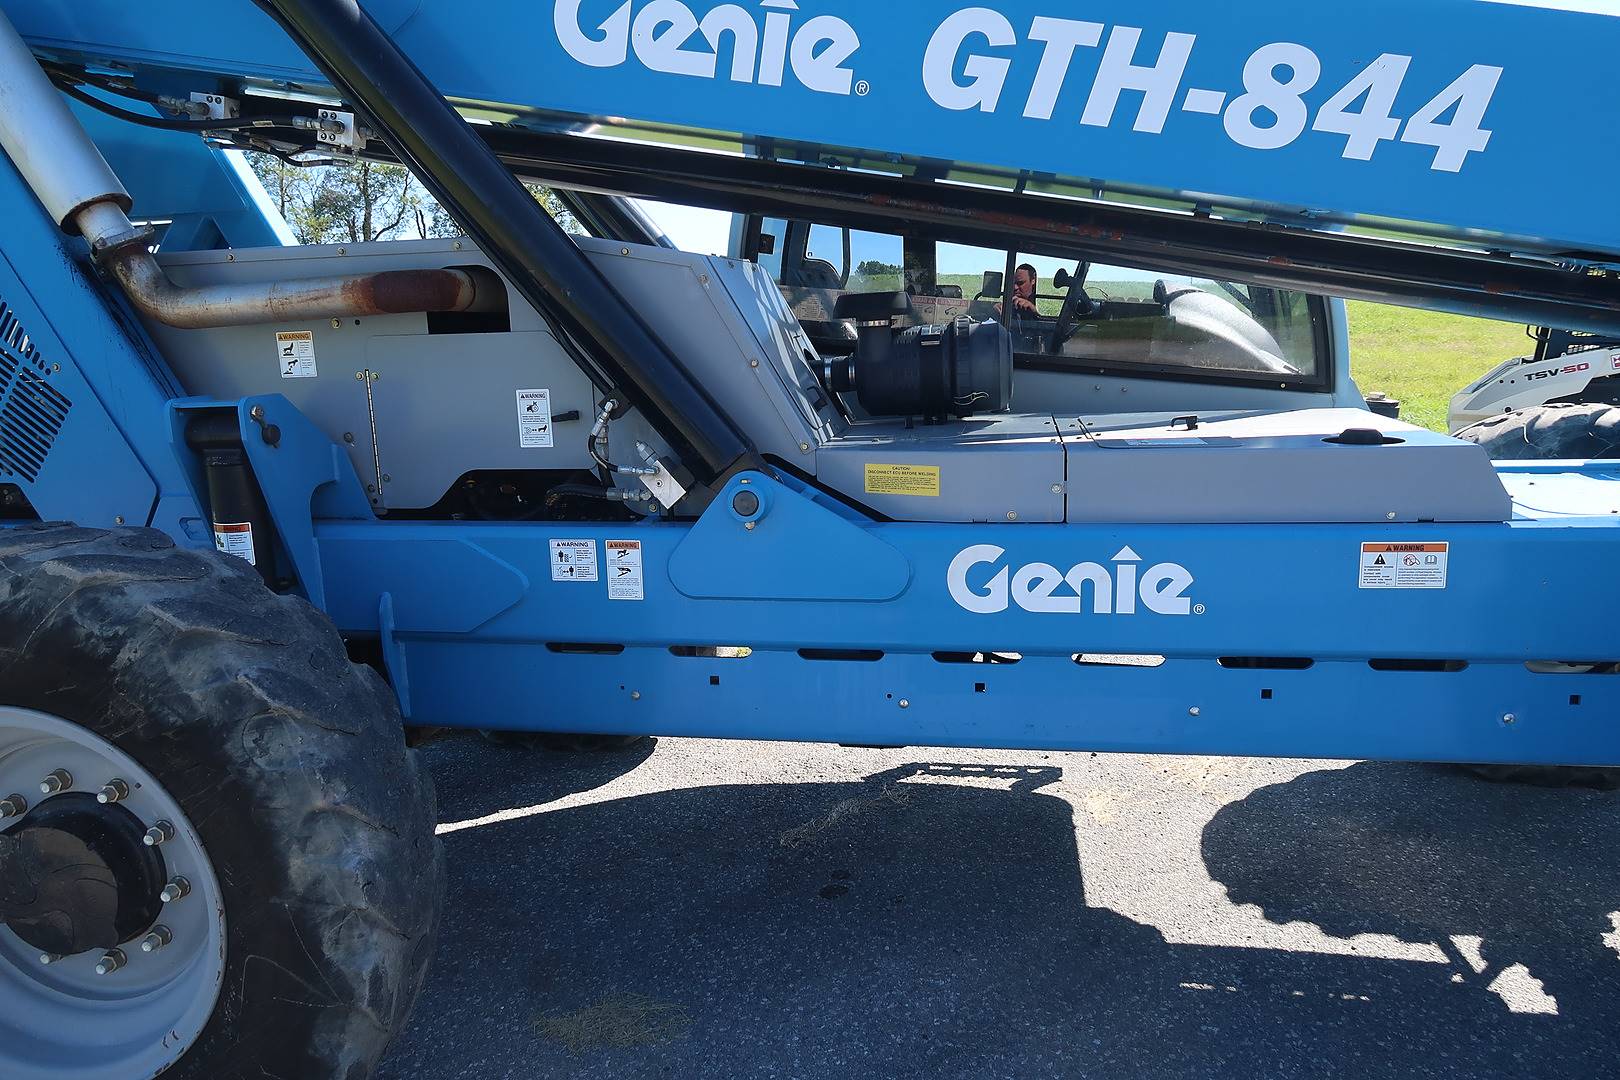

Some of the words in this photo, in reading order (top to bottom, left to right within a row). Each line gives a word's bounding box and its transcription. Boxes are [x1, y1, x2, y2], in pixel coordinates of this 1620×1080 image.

[553, 0, 861, 95] Genie
[921, 6, 1504, 173] GTH-844
[1524, 362, 1590, 381] TSV-50
[947, 544, 1194, 614] Genie
